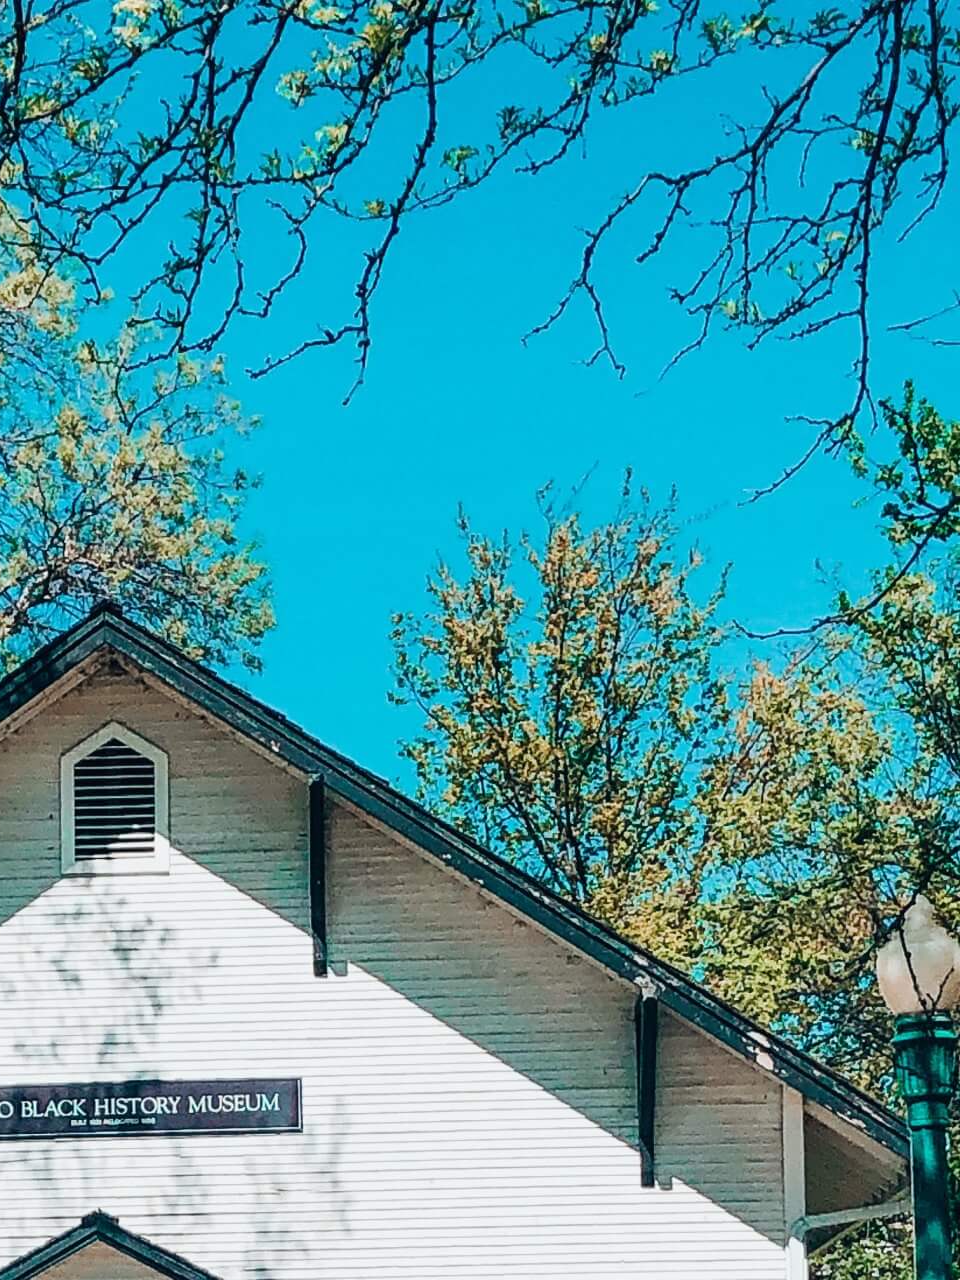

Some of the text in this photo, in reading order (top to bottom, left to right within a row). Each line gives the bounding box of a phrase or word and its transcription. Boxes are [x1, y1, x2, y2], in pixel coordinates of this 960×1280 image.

[22, 1099, 86, 1118] BLACK
[94, 1097, 180, 1116] HISTORY
[188, 1094, 281, 1113] MUSEUM
